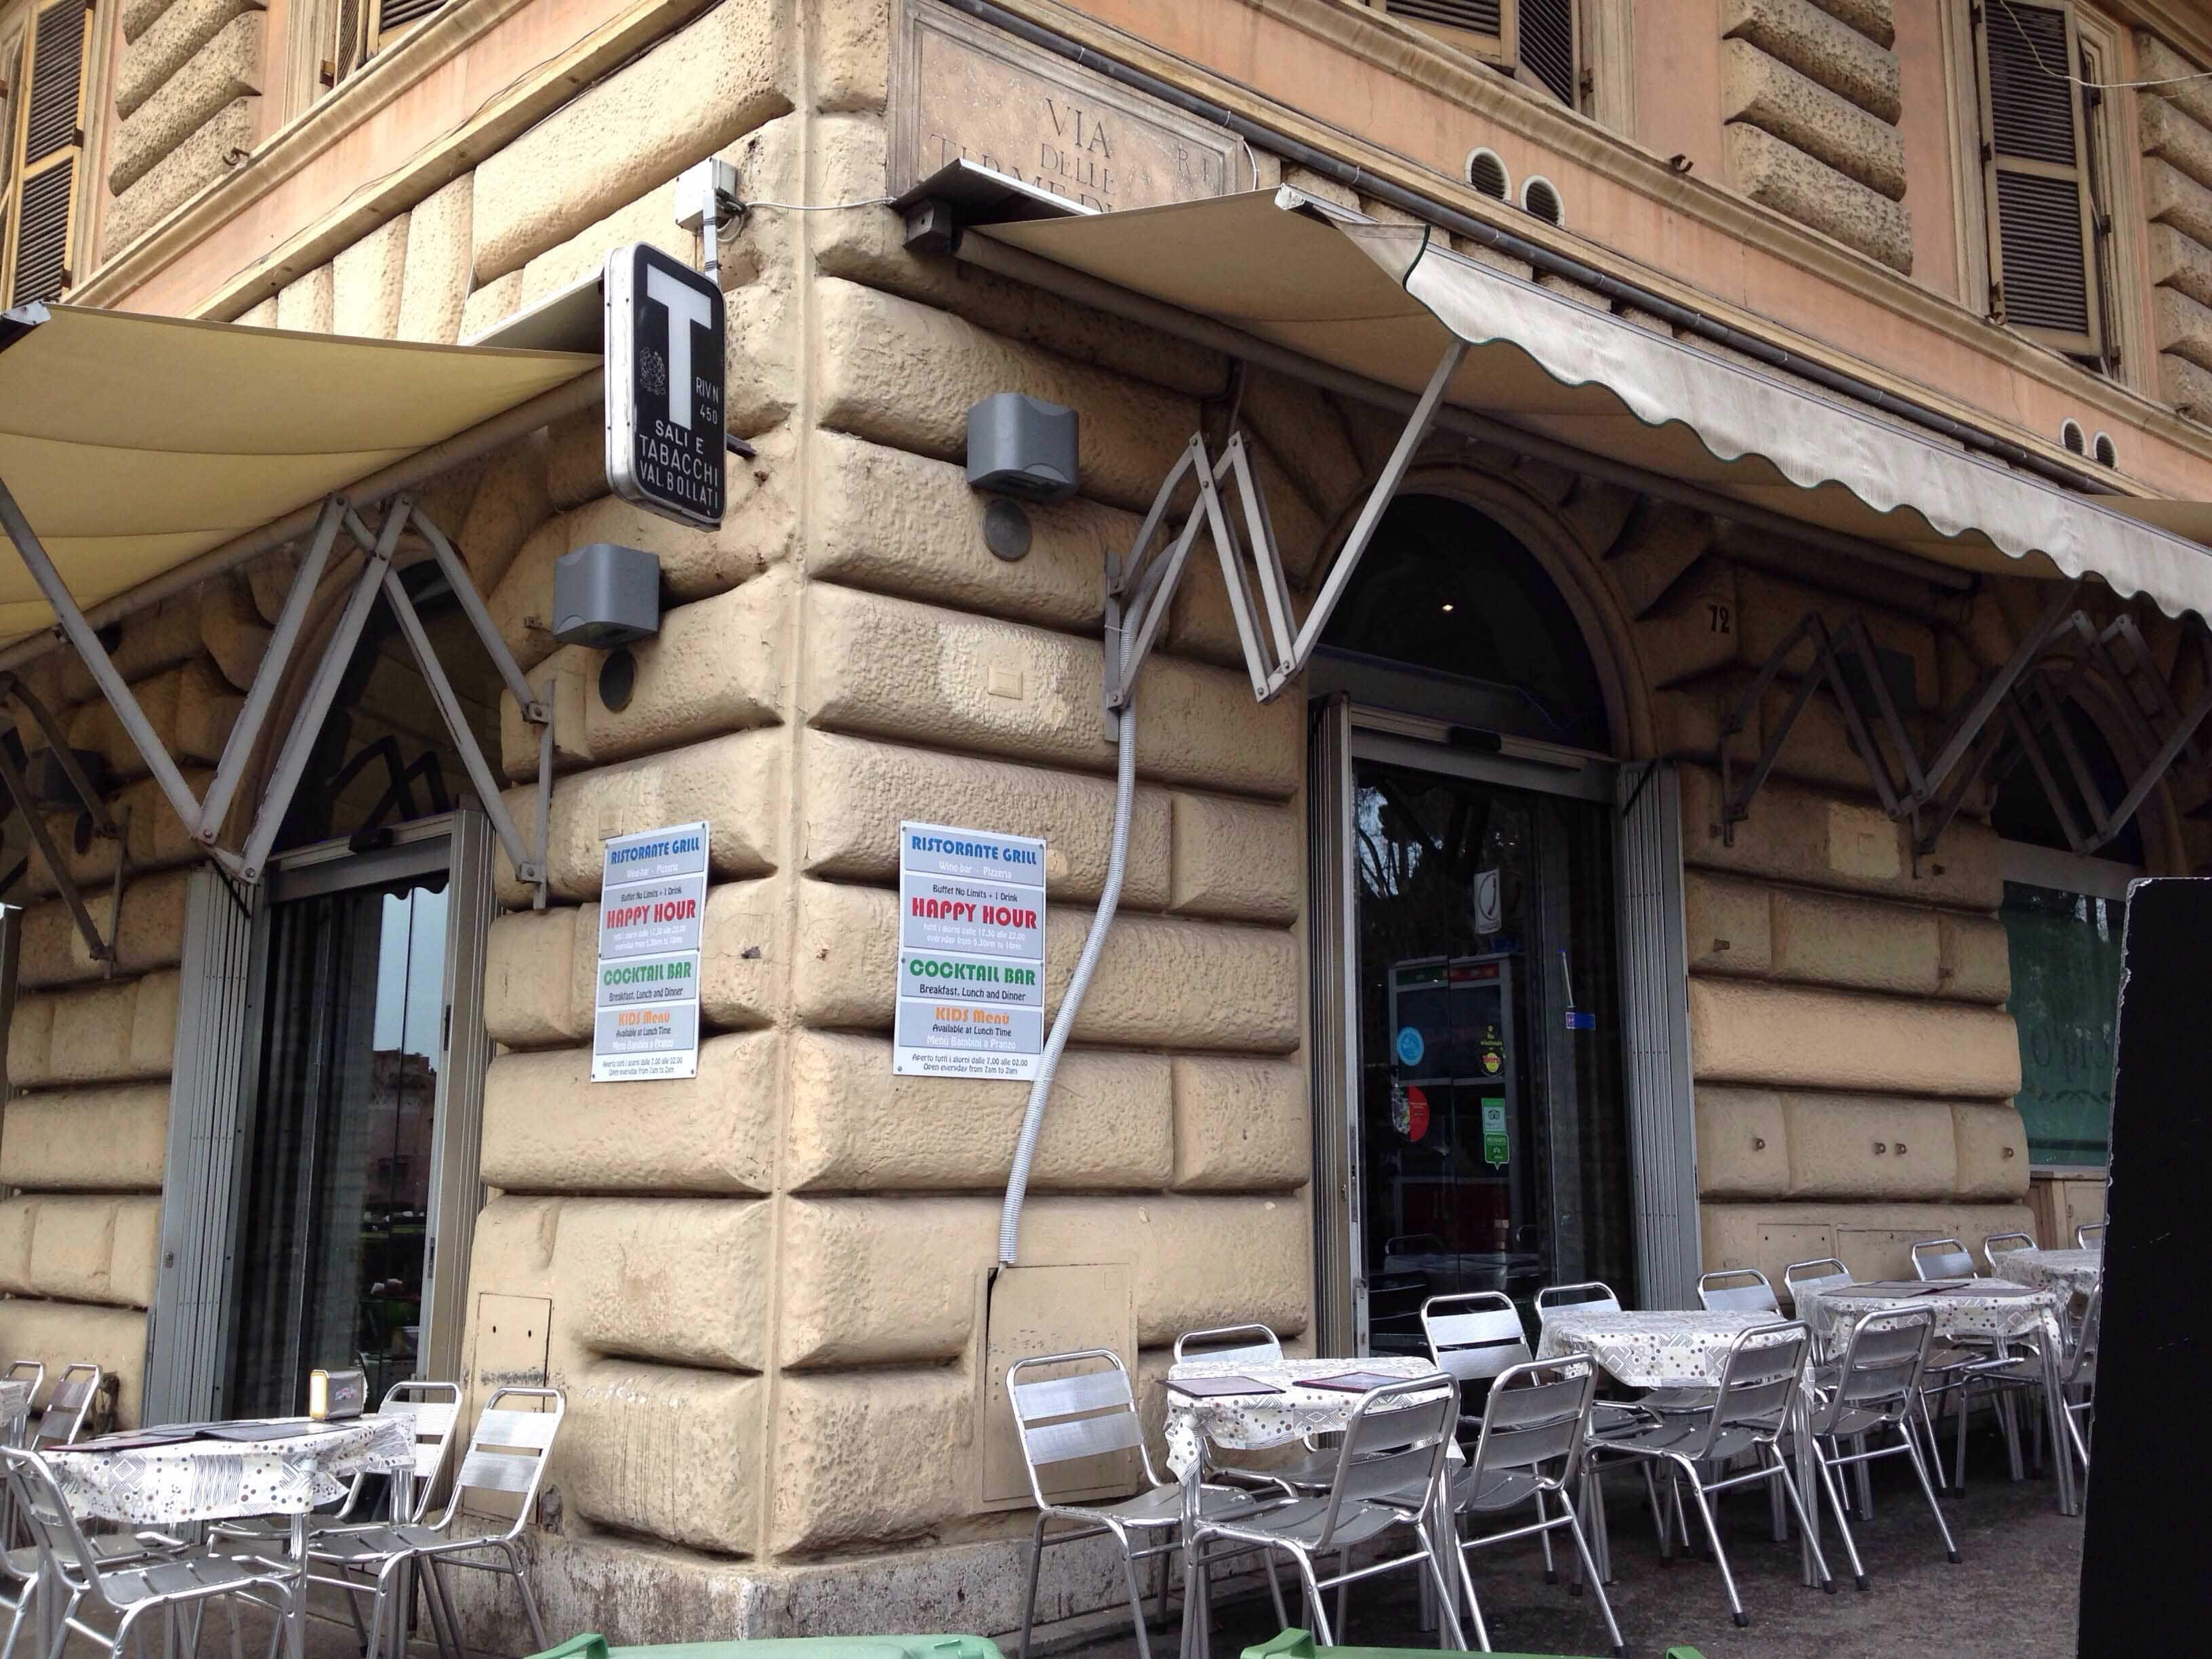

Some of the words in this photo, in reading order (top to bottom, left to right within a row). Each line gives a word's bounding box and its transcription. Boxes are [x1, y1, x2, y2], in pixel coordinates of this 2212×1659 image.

[1046, 98, 1111, 159] VIA
[1041, 143, 1117, 196] DELLE
[647, 263, 712, 430] T
[699, 403, 718, 425] 450
[655, 419, 688, 447] SALI
[695, 437, 704, 455] E
[639, 434, 718, 487] TABACCHI
[1708, 605, 1729, 634] 72
[611, 841, 669, 864] RISTORANTE
[672, 836, 699, 854] GRILL
[912, 835, 998, 859] RISTORANTE
[1002, 847, 1037, 865] GRILL
[939, 860, 971, 874] Wine-bar
[983, 866, 1011, 879] Pizzeria
[933, 884, 953, 895] Buffet
[956, 887, 964, 896] No
[966, 888, 986, 898] Limits
[1000, 893, 1017, 901] Drink
[606, 905, 650, 929] HAPPY
[653, 898, 696, 922] HOUR
[912, 897, 976, 922] HAPPY
[982, 905, 1036, 929] HOUR
[603, 963, 664, 986] COCKTAIL
[667, 960, 691, 979] BAR
[909, 958, 999, 983] COCKTAIL
[1004, 967, 1036, 985] BAR
[636, 989, 652, 999] Lunch
[653, 988, 663, 997] and
[664, 986, 682, 996] Dinner
[962, 987, 983, 998] Lunch
[986, 989, 999, 998] and
[1002, 991, 1025, 1001] Dinner
[617, 1011, 640, 1026] KIDS
[935, 1006, 968, 1022] KIDS
[658, 1025, 670, 1035] Time
[933, 1023, 963, 1033] Available
[974, 1026, 993, 1036] Lunch
[996, 1027, 1011, 1037] Time
[950, 1036, 981, 1048] Bambini
[990, 1039, 1015, 1050] Pranzo
[912, 1052, 933, 1062] Aperto
[971, 1056, 984, 1064] dalle
[987, 1057, 999, 1065] 7.00
[1012, 1058, 1027, 1067] 02.00
[969, 1065, 982, 1073] from
